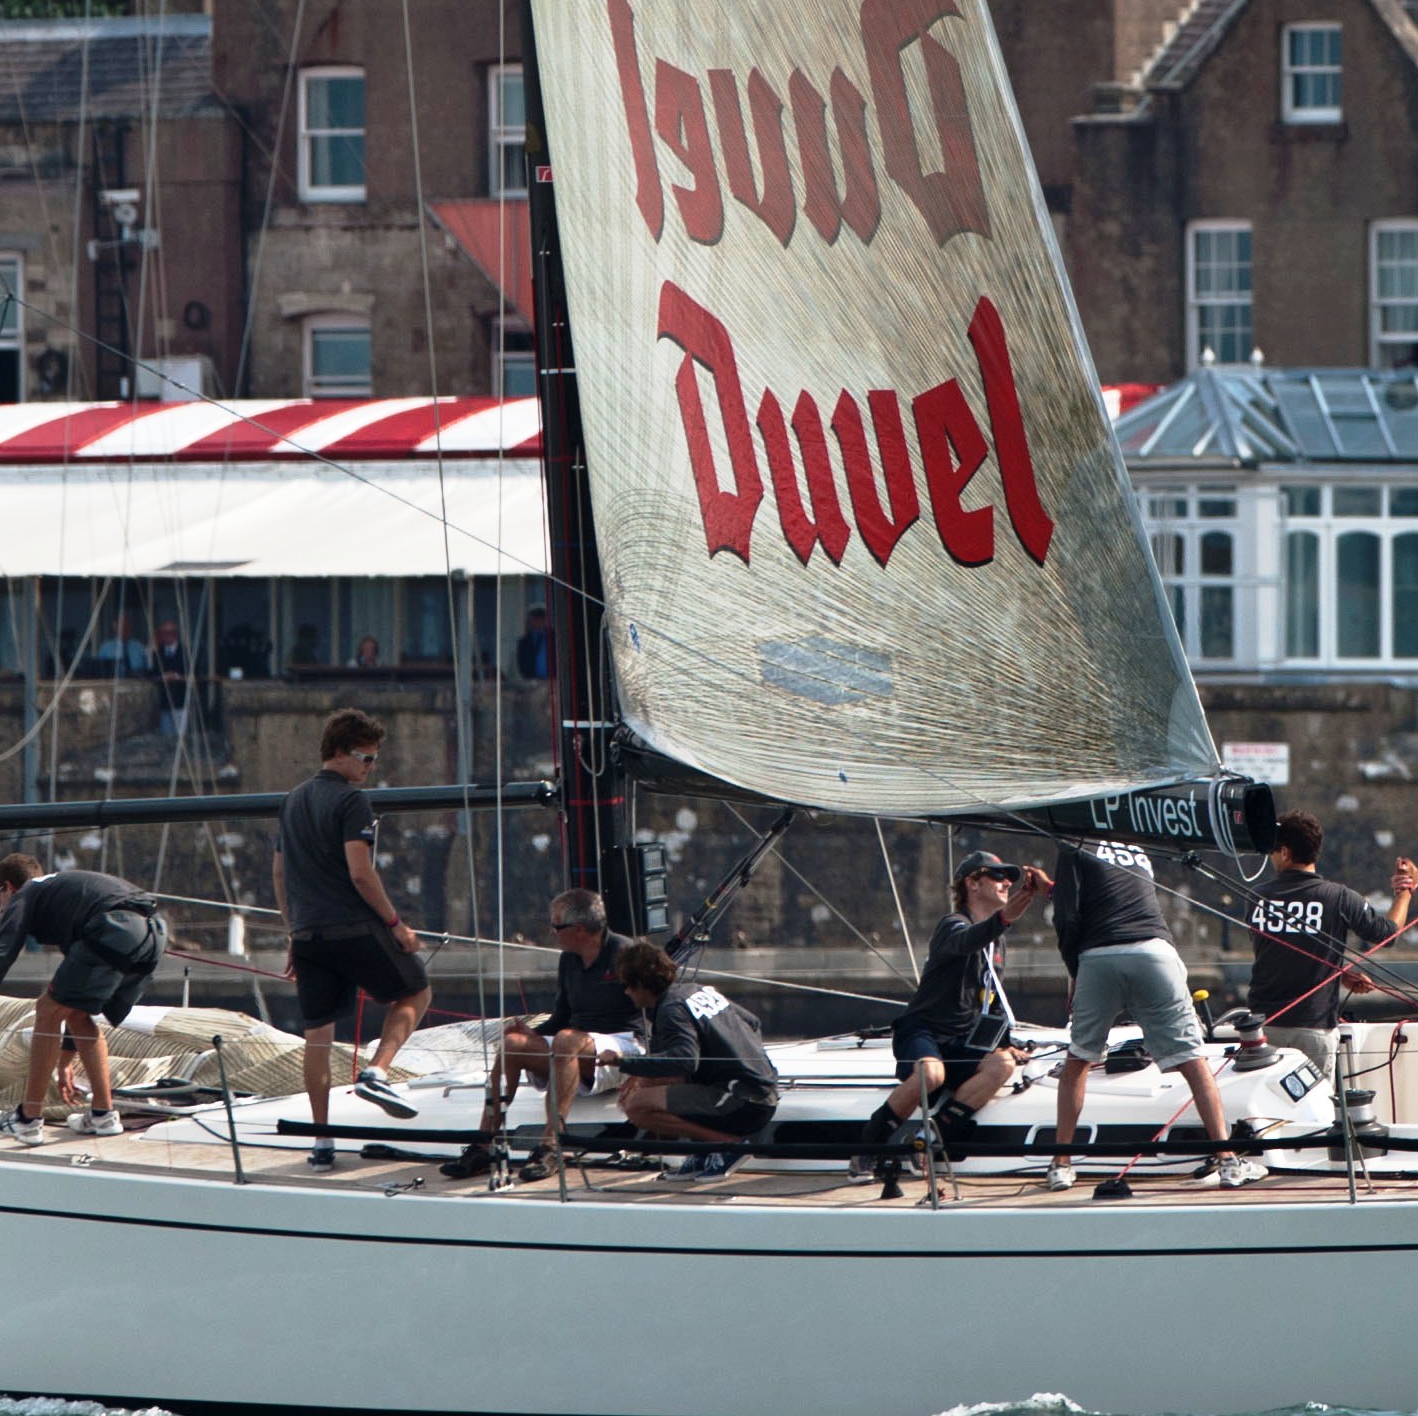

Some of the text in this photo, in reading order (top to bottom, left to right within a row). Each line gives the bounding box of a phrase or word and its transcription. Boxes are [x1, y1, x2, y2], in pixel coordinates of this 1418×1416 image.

[657, 280, 1055, 568] Duvel
[1090, 789, 1203, 838] LP Invest
[1251, 899, 1324, 934] 4528
